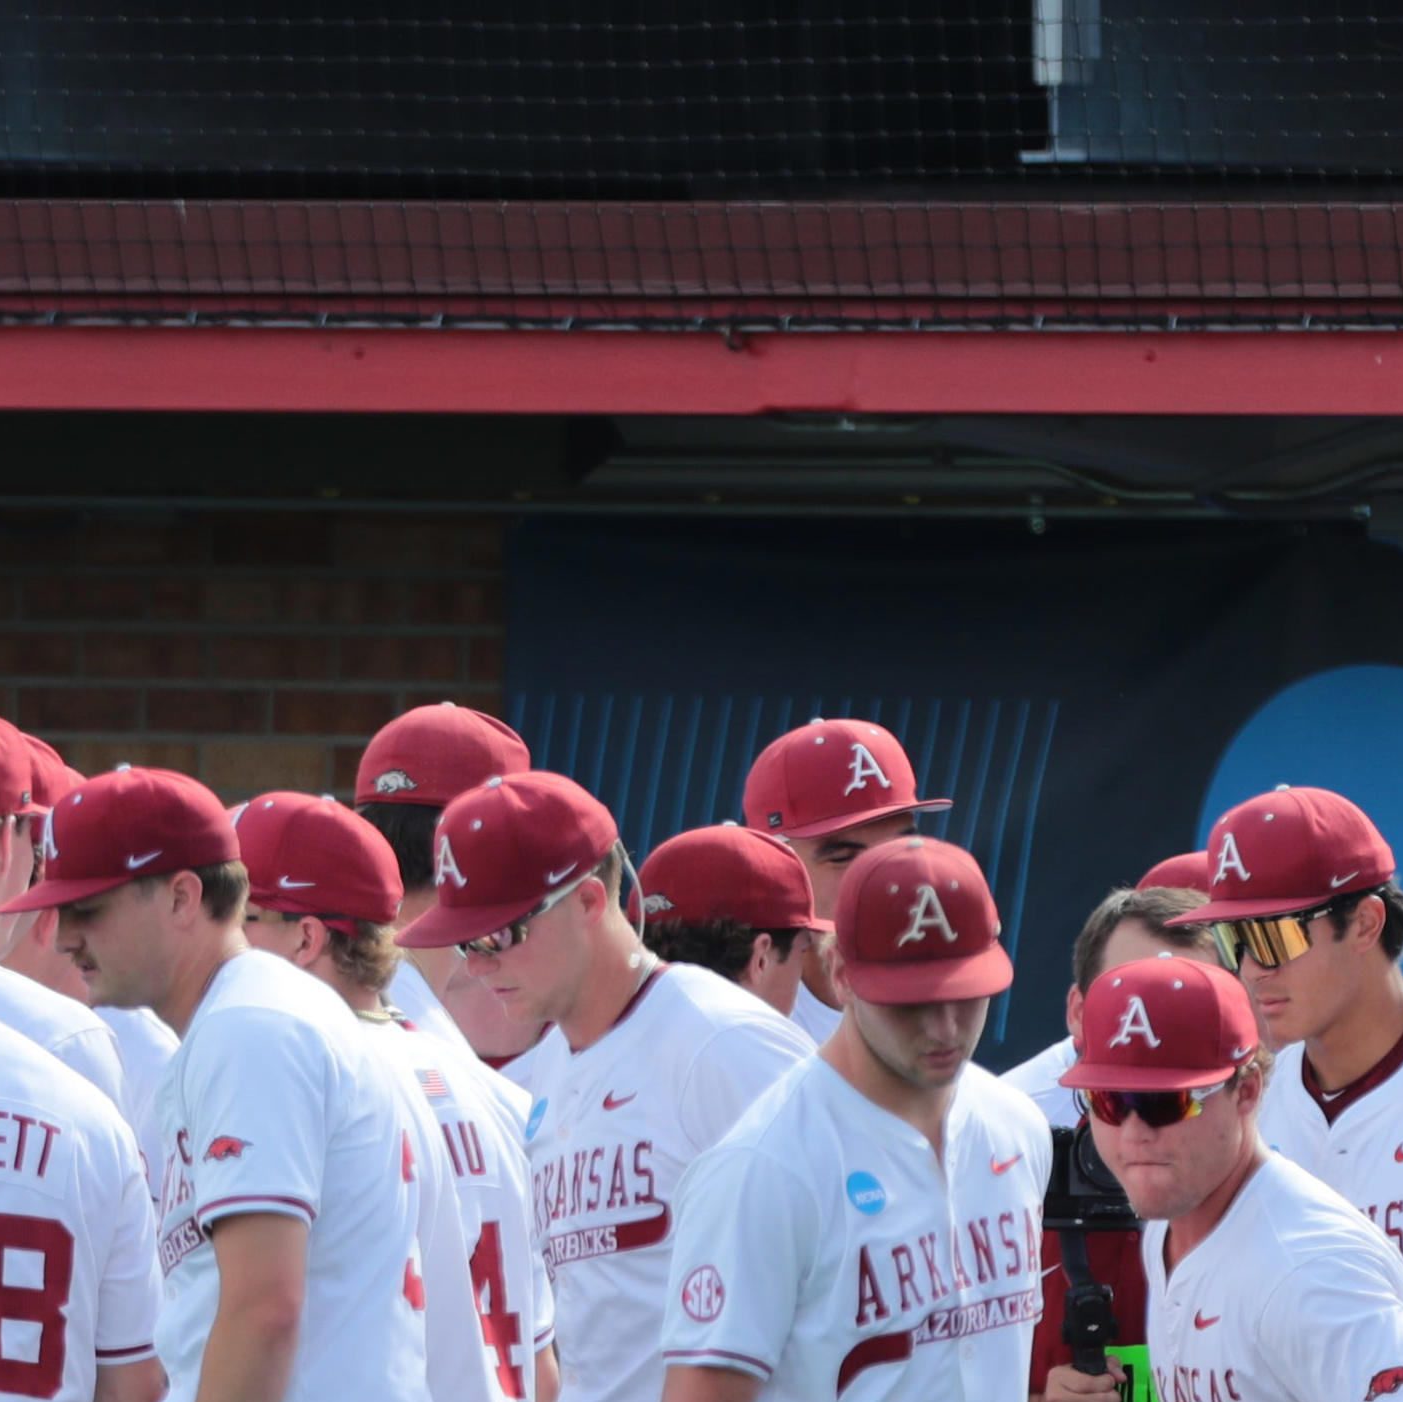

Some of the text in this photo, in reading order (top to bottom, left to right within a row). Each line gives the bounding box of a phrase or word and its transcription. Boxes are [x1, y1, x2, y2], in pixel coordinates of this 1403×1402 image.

[844, 743, 890, 797] A
[435, 834, 467, 887] A
[1212, 832, 1251, 886] A
[899, 885, 957, 948] A
[1109, 996, 1161, 1049] A
